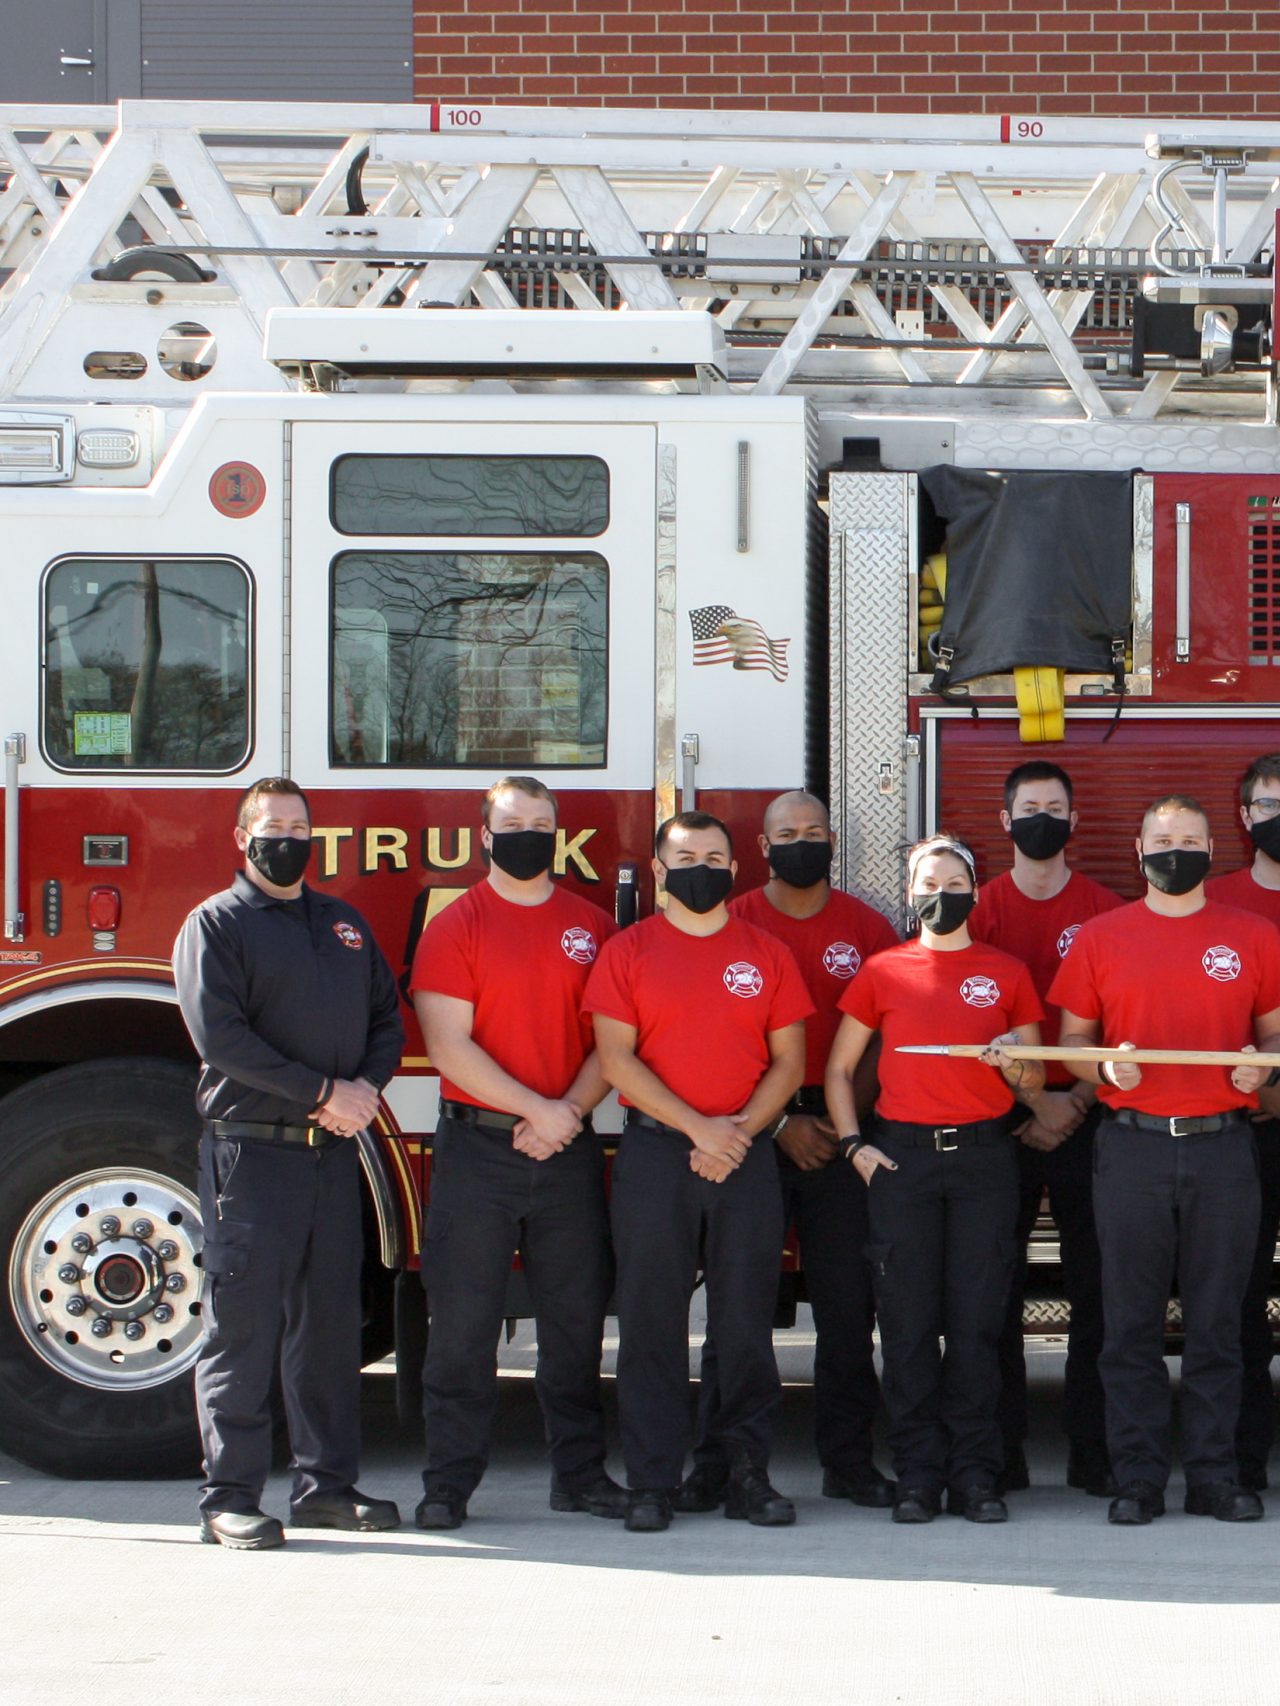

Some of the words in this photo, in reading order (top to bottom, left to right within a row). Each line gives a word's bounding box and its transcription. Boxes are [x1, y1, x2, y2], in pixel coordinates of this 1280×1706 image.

[447, 109, 482, 126] 100
[1017, 121, 1044, 138] 90
[311, 827, 600, 885] TRUK
